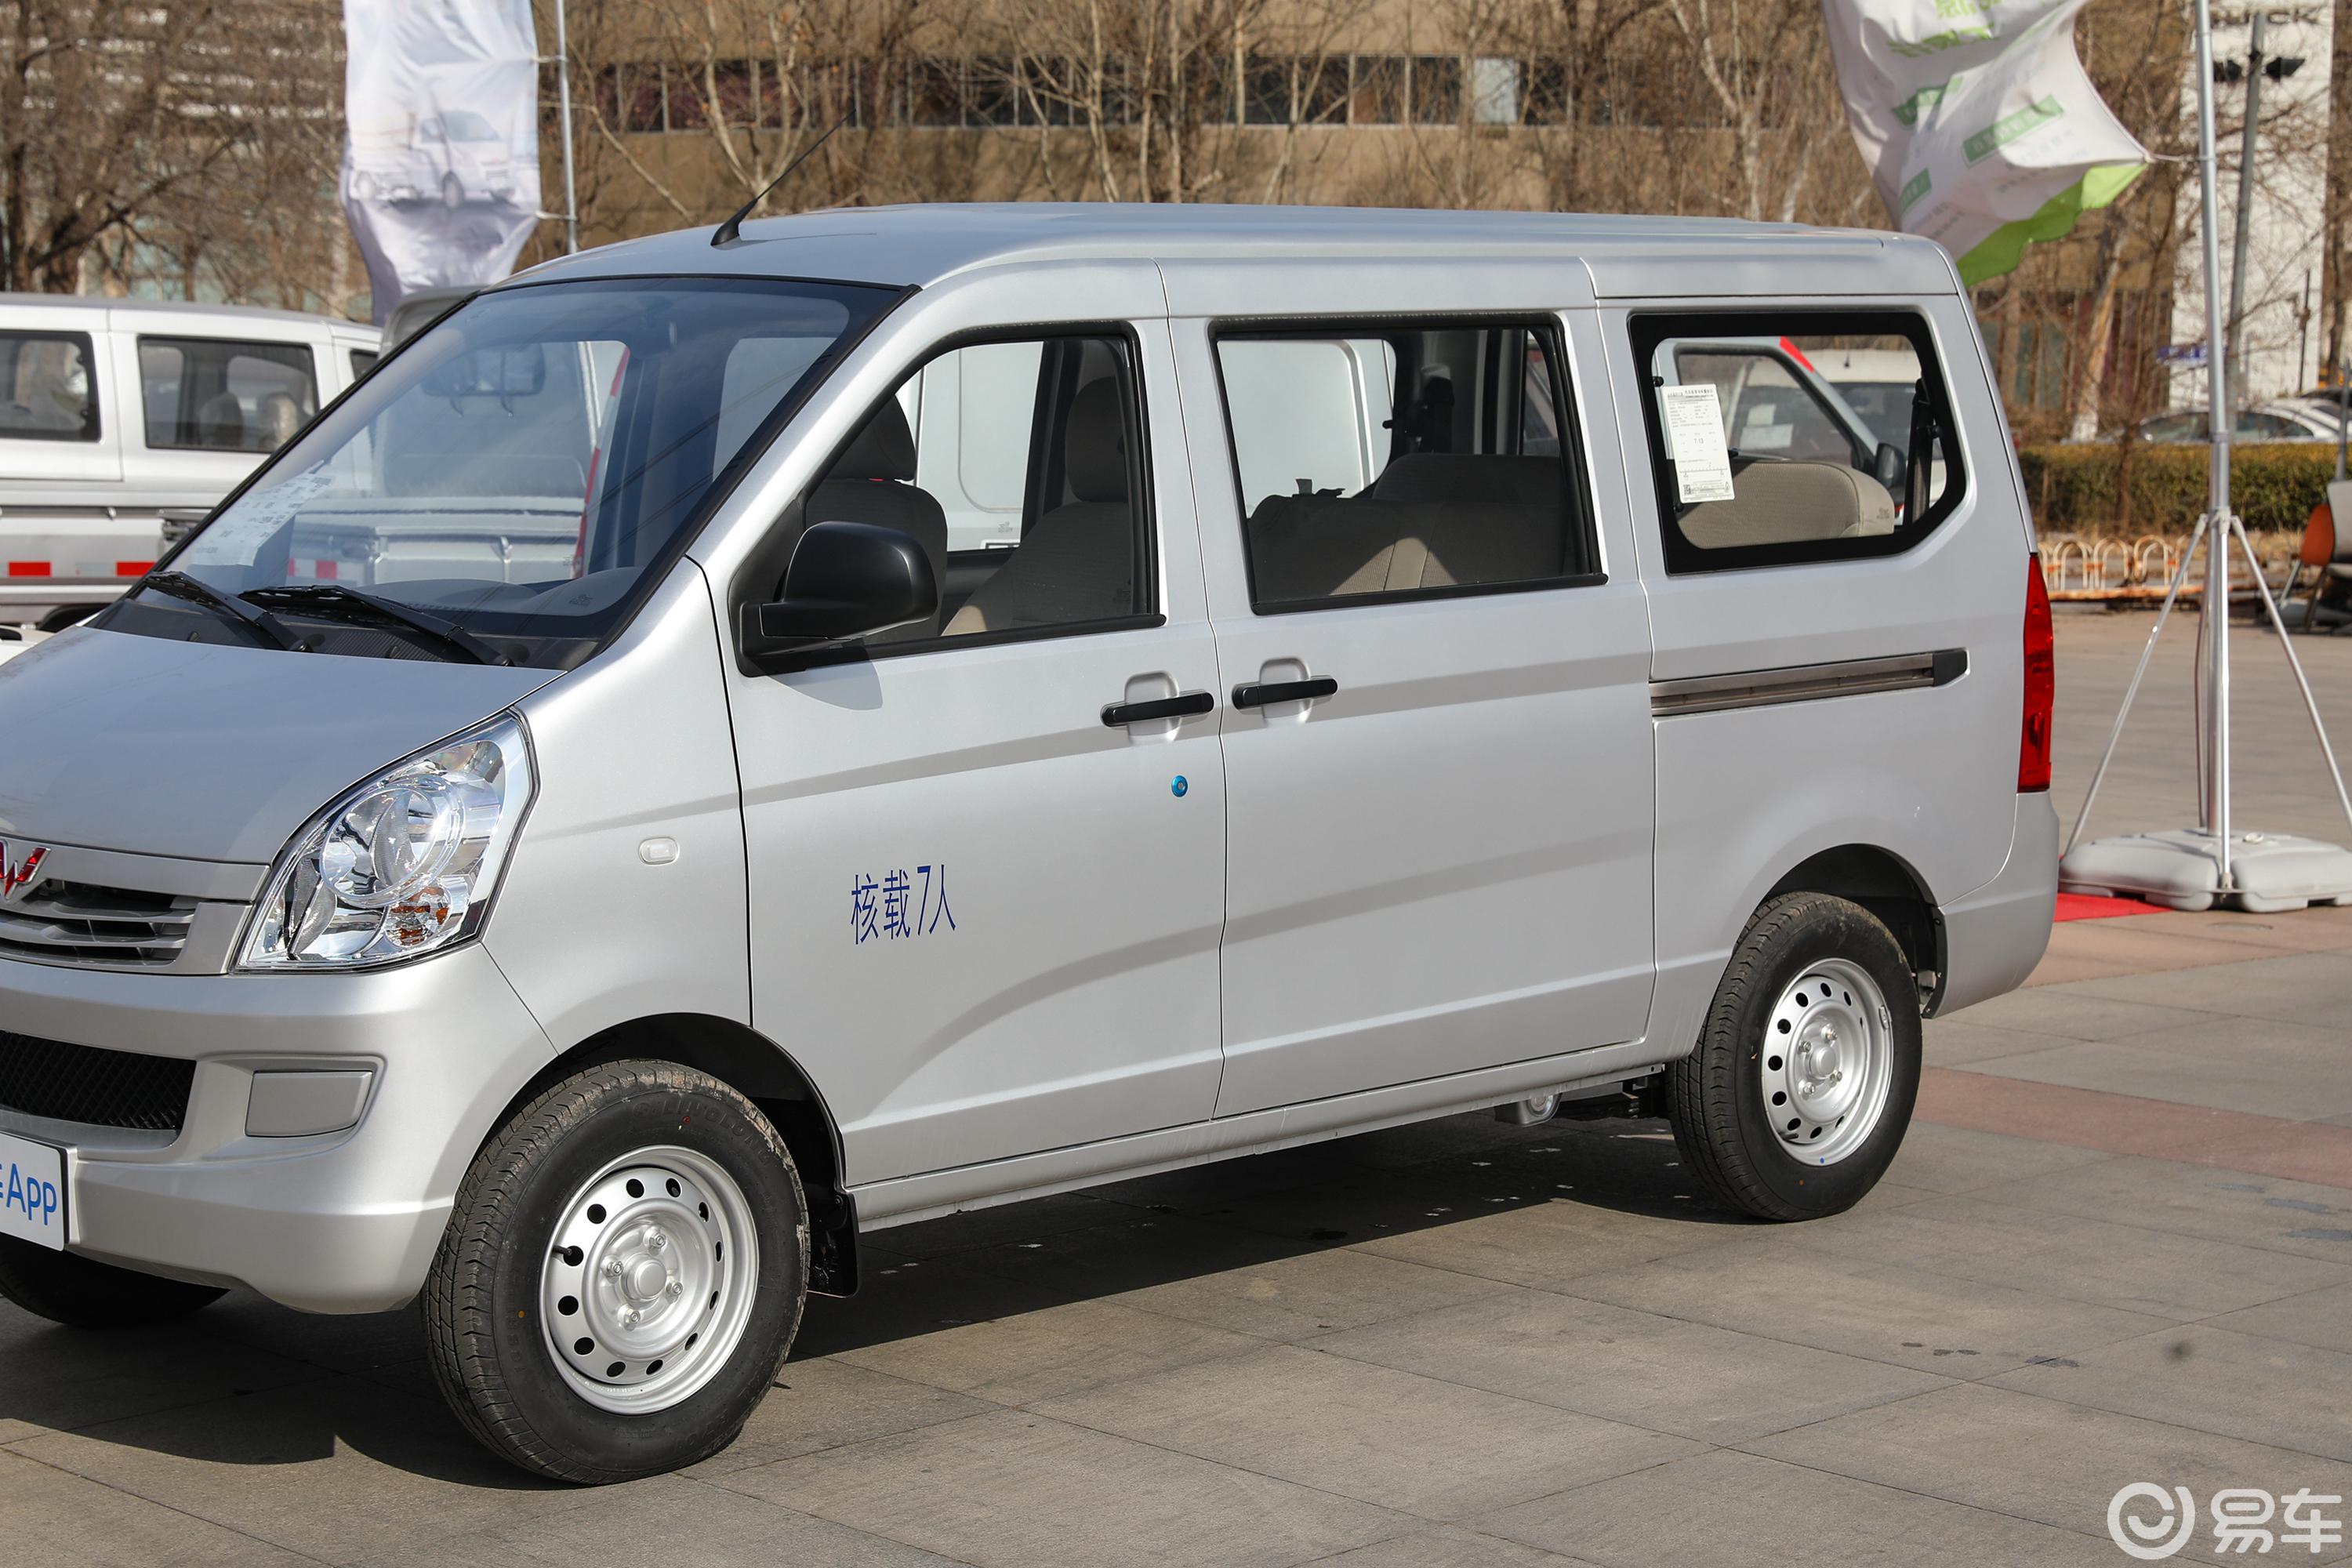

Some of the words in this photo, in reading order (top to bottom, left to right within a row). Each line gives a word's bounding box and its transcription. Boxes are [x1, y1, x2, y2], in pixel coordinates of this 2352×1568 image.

[851, 864, 956, 945] 核载7人
[0, 1163, 57, 1226] App
